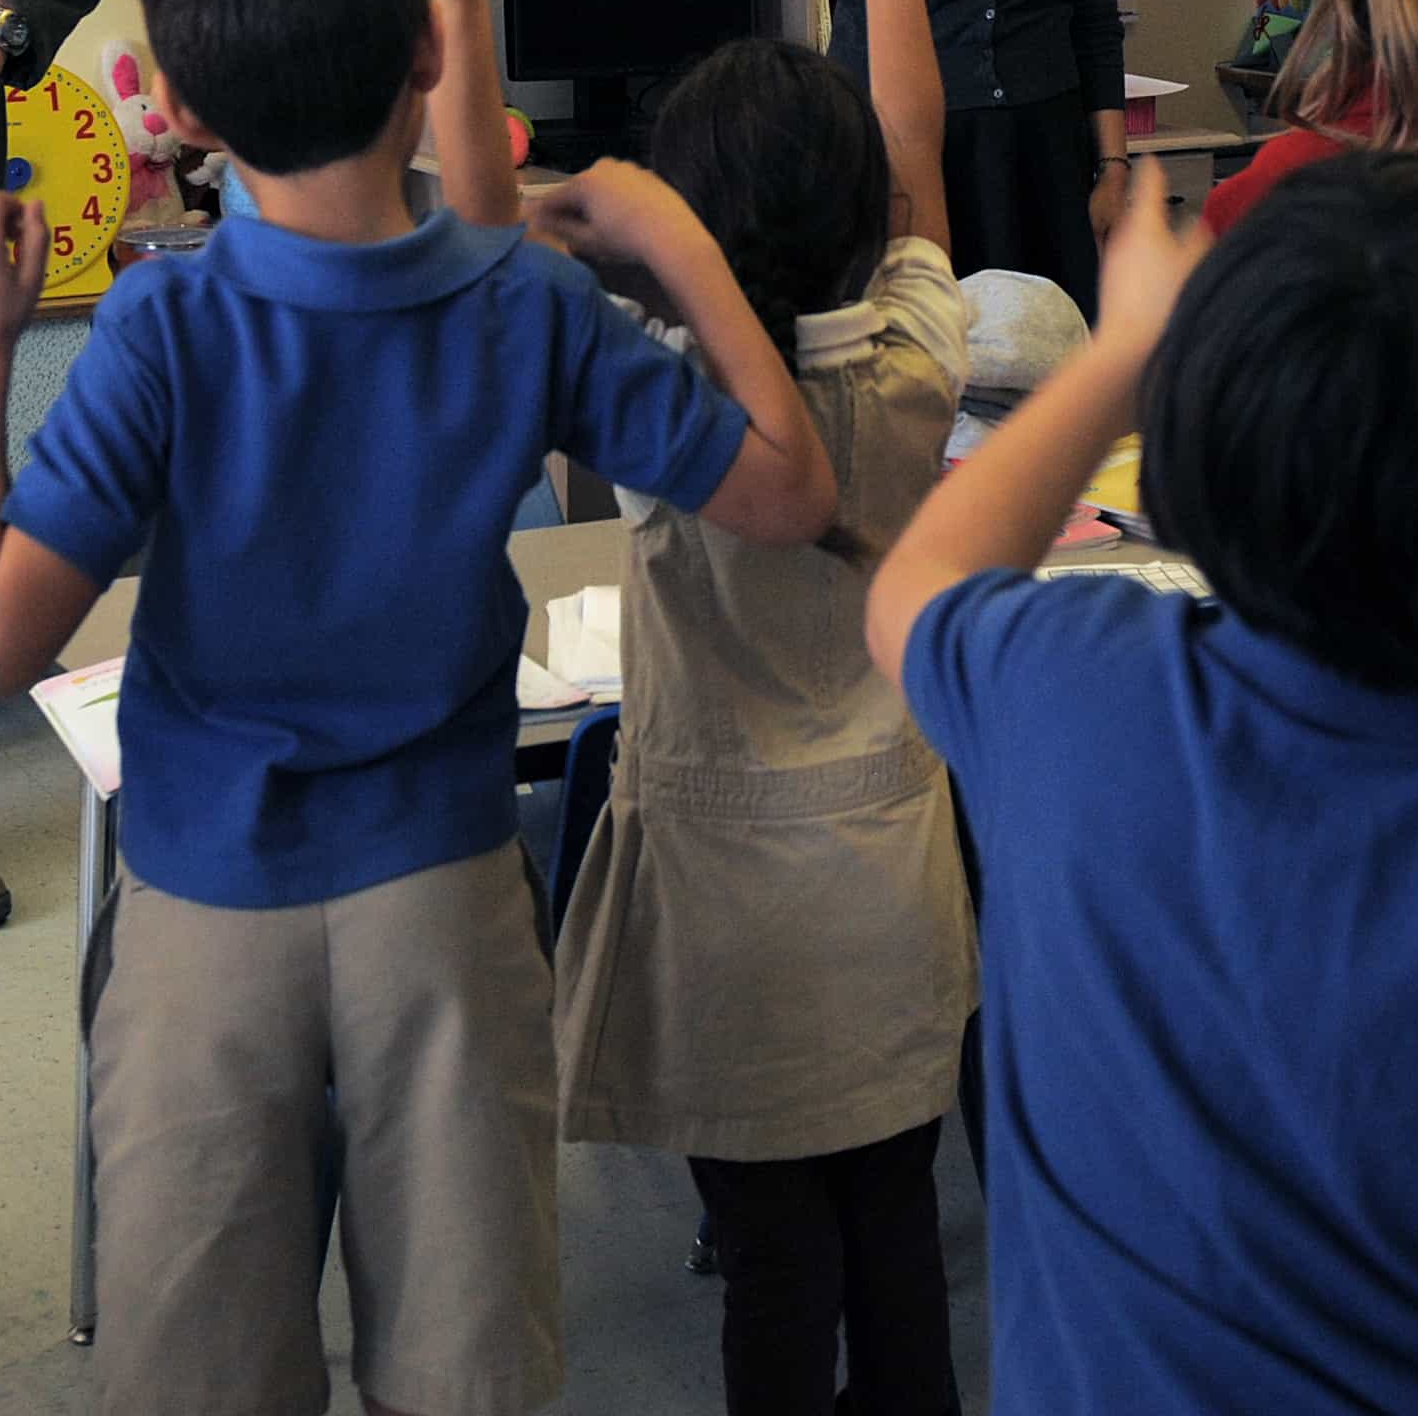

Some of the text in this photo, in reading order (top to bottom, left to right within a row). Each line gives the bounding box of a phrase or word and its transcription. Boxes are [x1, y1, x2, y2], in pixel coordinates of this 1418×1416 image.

[43, 82, 59, 111] 1
[73, 110, 97, 140] 2
[92, 153, 113, 184] 3
[81, 196, 103, 225] 4
[53, 226, 74, 256] 5
